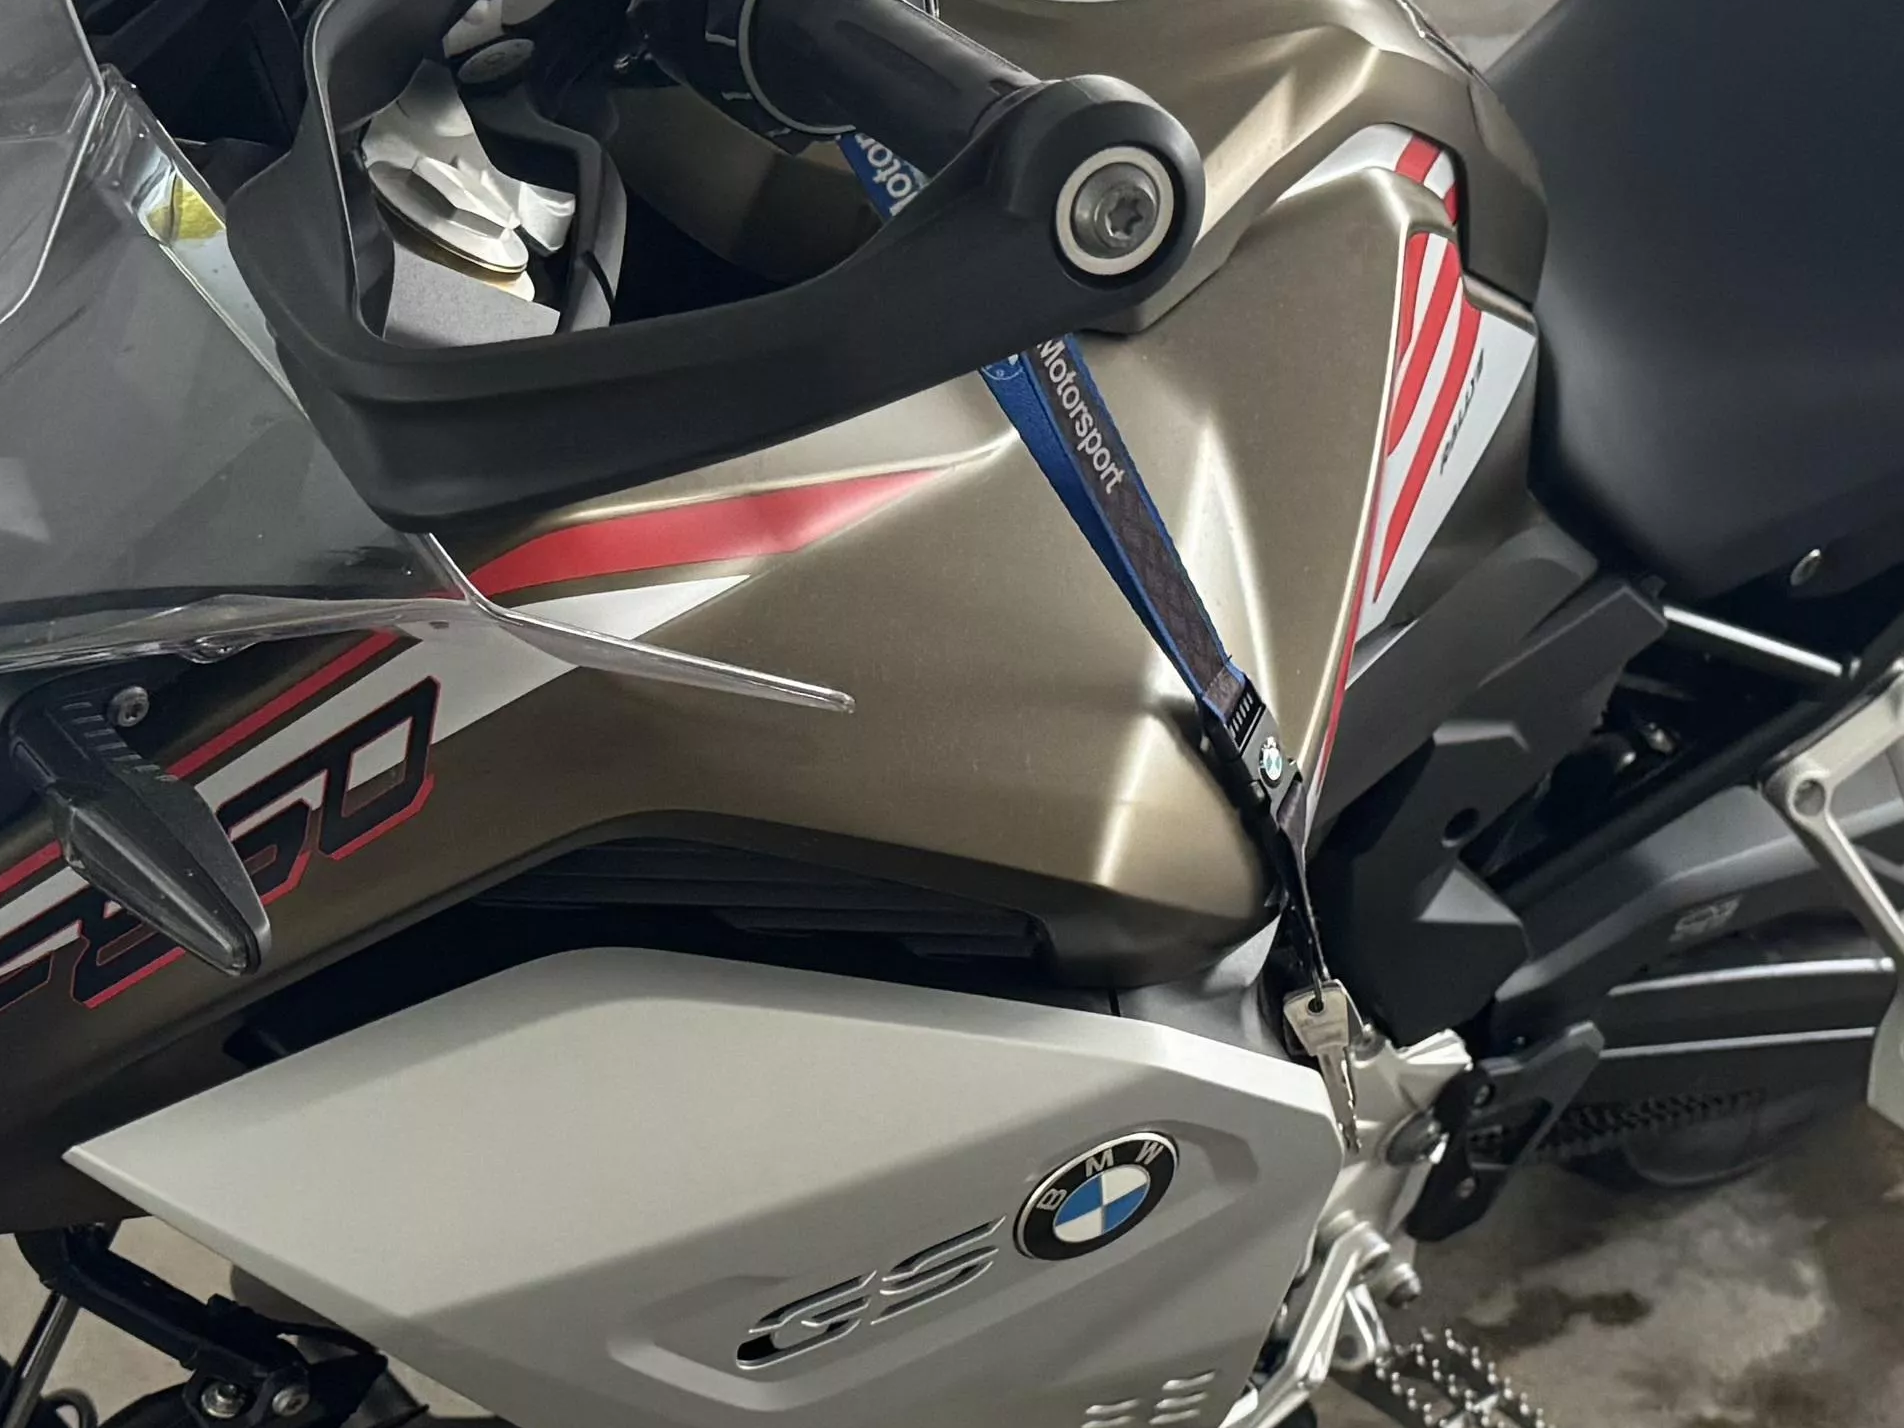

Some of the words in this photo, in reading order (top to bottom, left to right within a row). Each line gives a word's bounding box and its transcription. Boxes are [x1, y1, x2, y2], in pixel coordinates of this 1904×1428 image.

[1036, 340, 1126, 495] Motorsport
[1035, 1140, 1164, 1212] BMW
[735, 1215, 1006, 1371] GS
